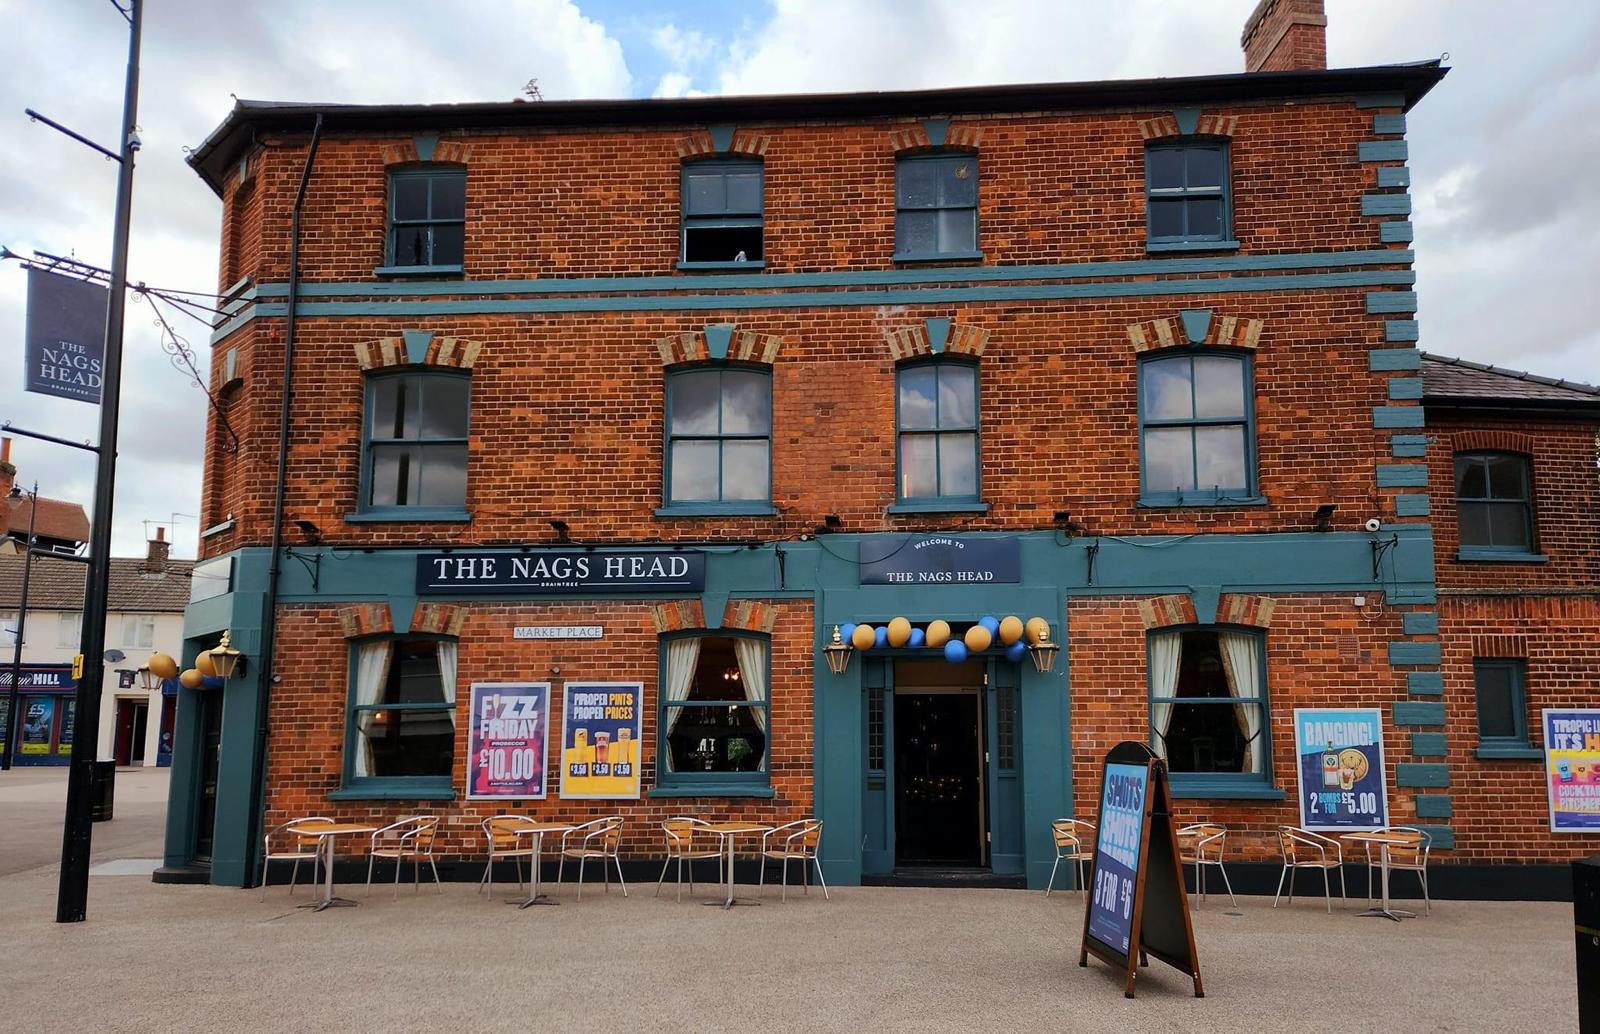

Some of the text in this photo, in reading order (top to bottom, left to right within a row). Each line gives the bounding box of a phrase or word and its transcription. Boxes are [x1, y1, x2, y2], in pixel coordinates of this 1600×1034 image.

[59, 341, 86, 354] THE
[42, 347, 101, 373] NAGS
[40, 363, 101, 388] HEAD
[914, 538, 965, 550] WELCOME TO
[433, 556, 689, 579] THE NAGS HEAD
[886, 571, 993, 582] THE NAGS HEAD
[516, 627, 600, 637] MARKET PLACE
[33, 673, 60, 685] HILL
[574, 693, 633, 706] PROPER PINTS
[573, 706, 633, 720] PROPER PRICES
[480, 719, 538, 740] FRIDAY
[1304, 722, 1373, 746] BANGING!
[1552, 719, 1592, 733] TROPIC
[479, 748, 534, 780] £10.00
[1107, 774, 1142, 811] SHOTS
[1310, 792, 1319, 814] 2
[1341, 792, 1377, 814] £5.00
[1103, 810, 1139, 850] SHOTS
[1095, 868, 1132, 920] 3 FOR £6
